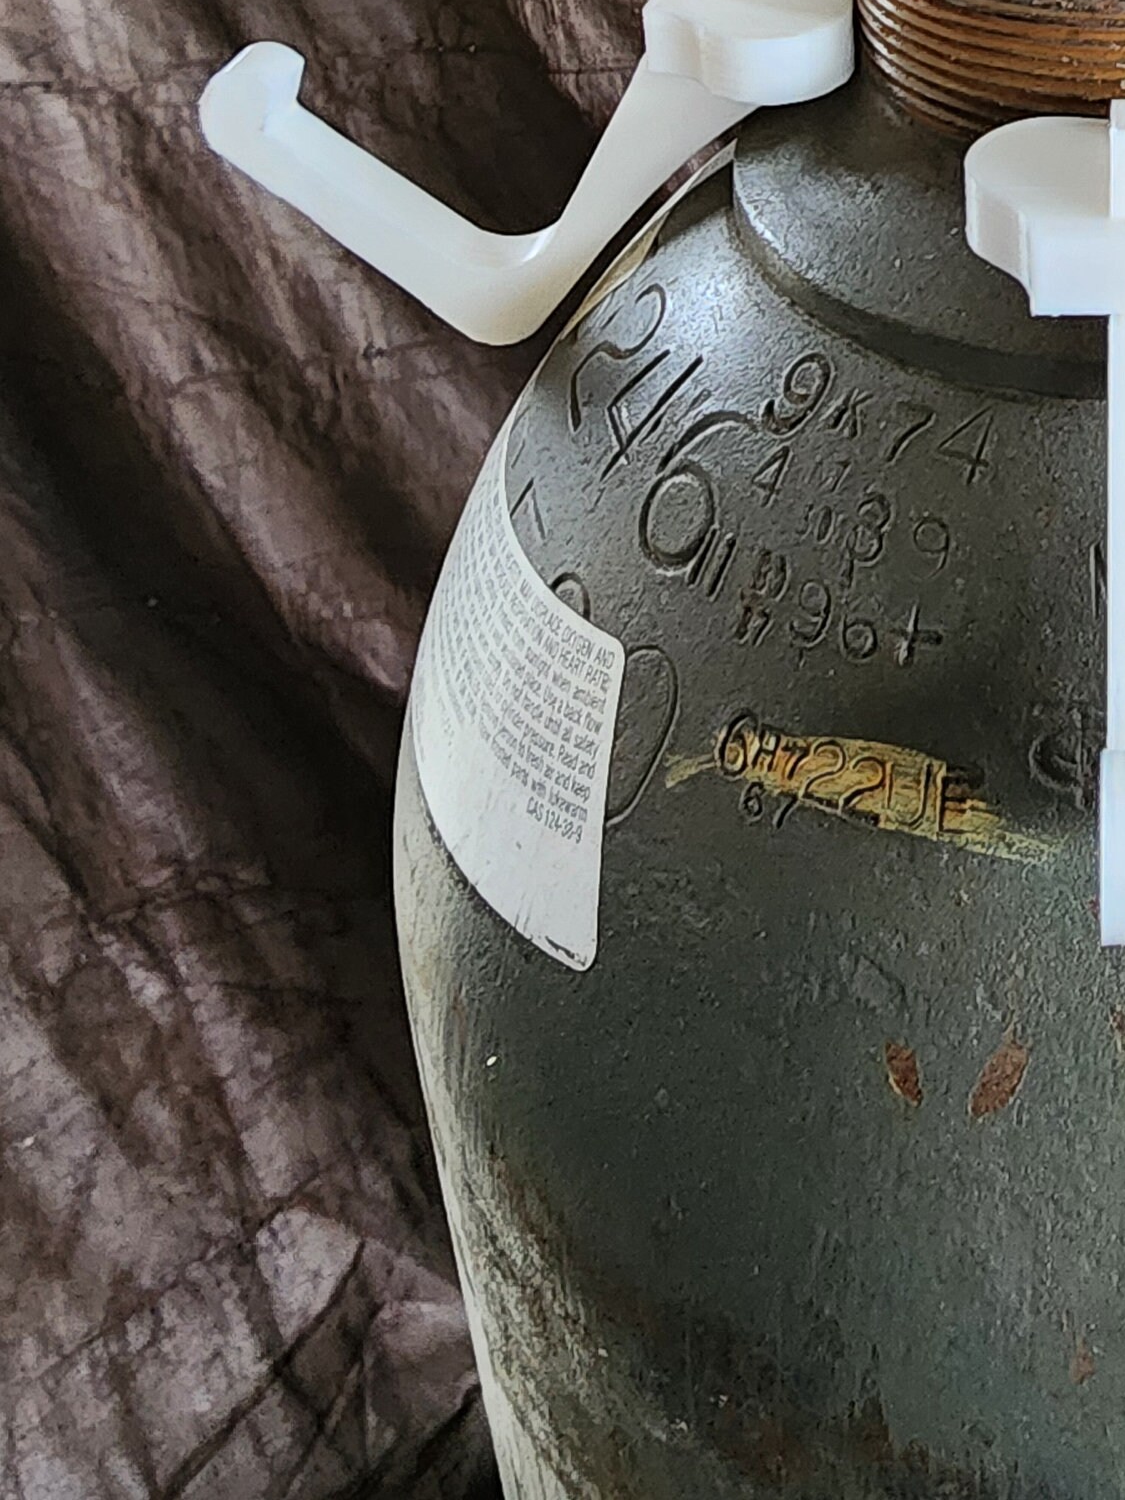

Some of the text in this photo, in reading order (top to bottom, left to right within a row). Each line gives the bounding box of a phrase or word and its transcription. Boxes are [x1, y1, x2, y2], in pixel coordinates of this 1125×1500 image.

[555, 647, 587, 677] HEART
[559, 624, 596, 659] OXYGEN
[592, 646, 618, 670] AND
[525, 795, 549, 821] CAS
